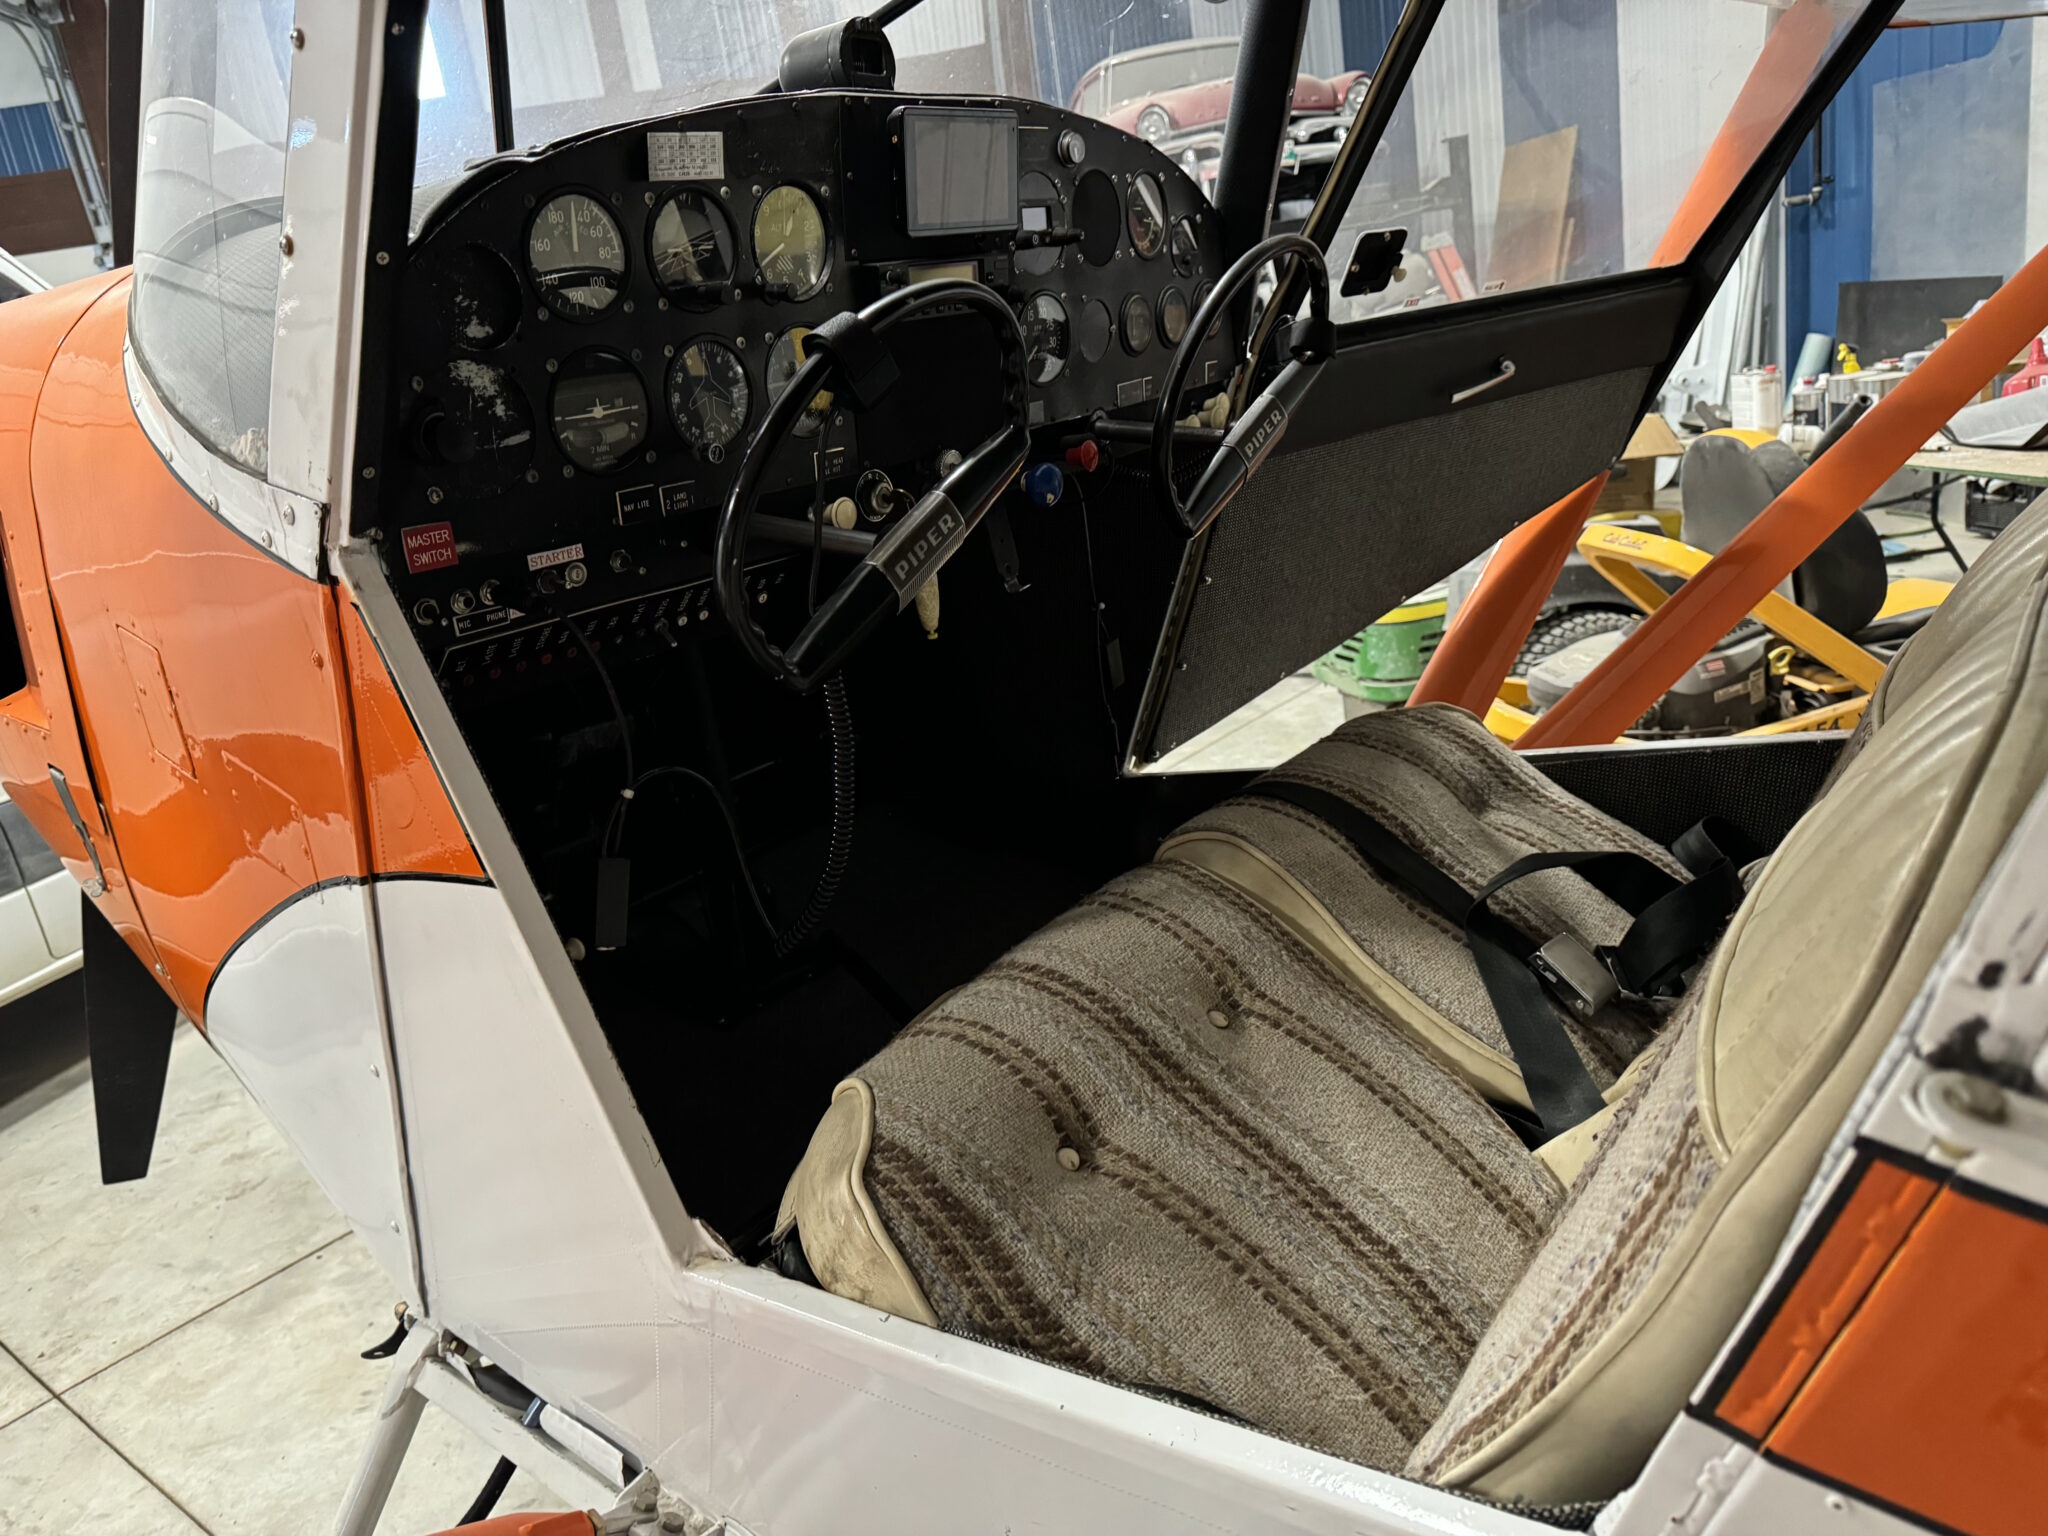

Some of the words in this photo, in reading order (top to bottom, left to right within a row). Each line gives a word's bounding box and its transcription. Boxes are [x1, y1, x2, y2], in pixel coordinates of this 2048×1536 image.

[548, 210, 564, 224] 180
[577, 210, 590, 223] 40
[590, 225, 603, 238] 60
[534, 238, 551, 252] 160
[598, 247, 612, 259] 80
[590, 276, 606, 288] 100
[569, 290, 584, 303] 120
[1027, 310, 1034, 322] 15
[1049, 336, 1057, 348] 30
[1244, 410, 1282, 457] PIPER
[624, 502, 635, 512] NAV
[636, 499, 651, 510] LITE
[666, 500, 671, 510] 2
[673, 491, 687, 501] LAND
[673, 500, 689, 511] LIGHT
[406, 529, 450, 549] MASTER
[894, 513, 956, 580] PIPER
[413, 548, 452, 567] SWITCH
[530, 546, 583, 568] STARTER
[458, 619, 472, 630] MIC
[486, 611, 507, 623] PHONE
